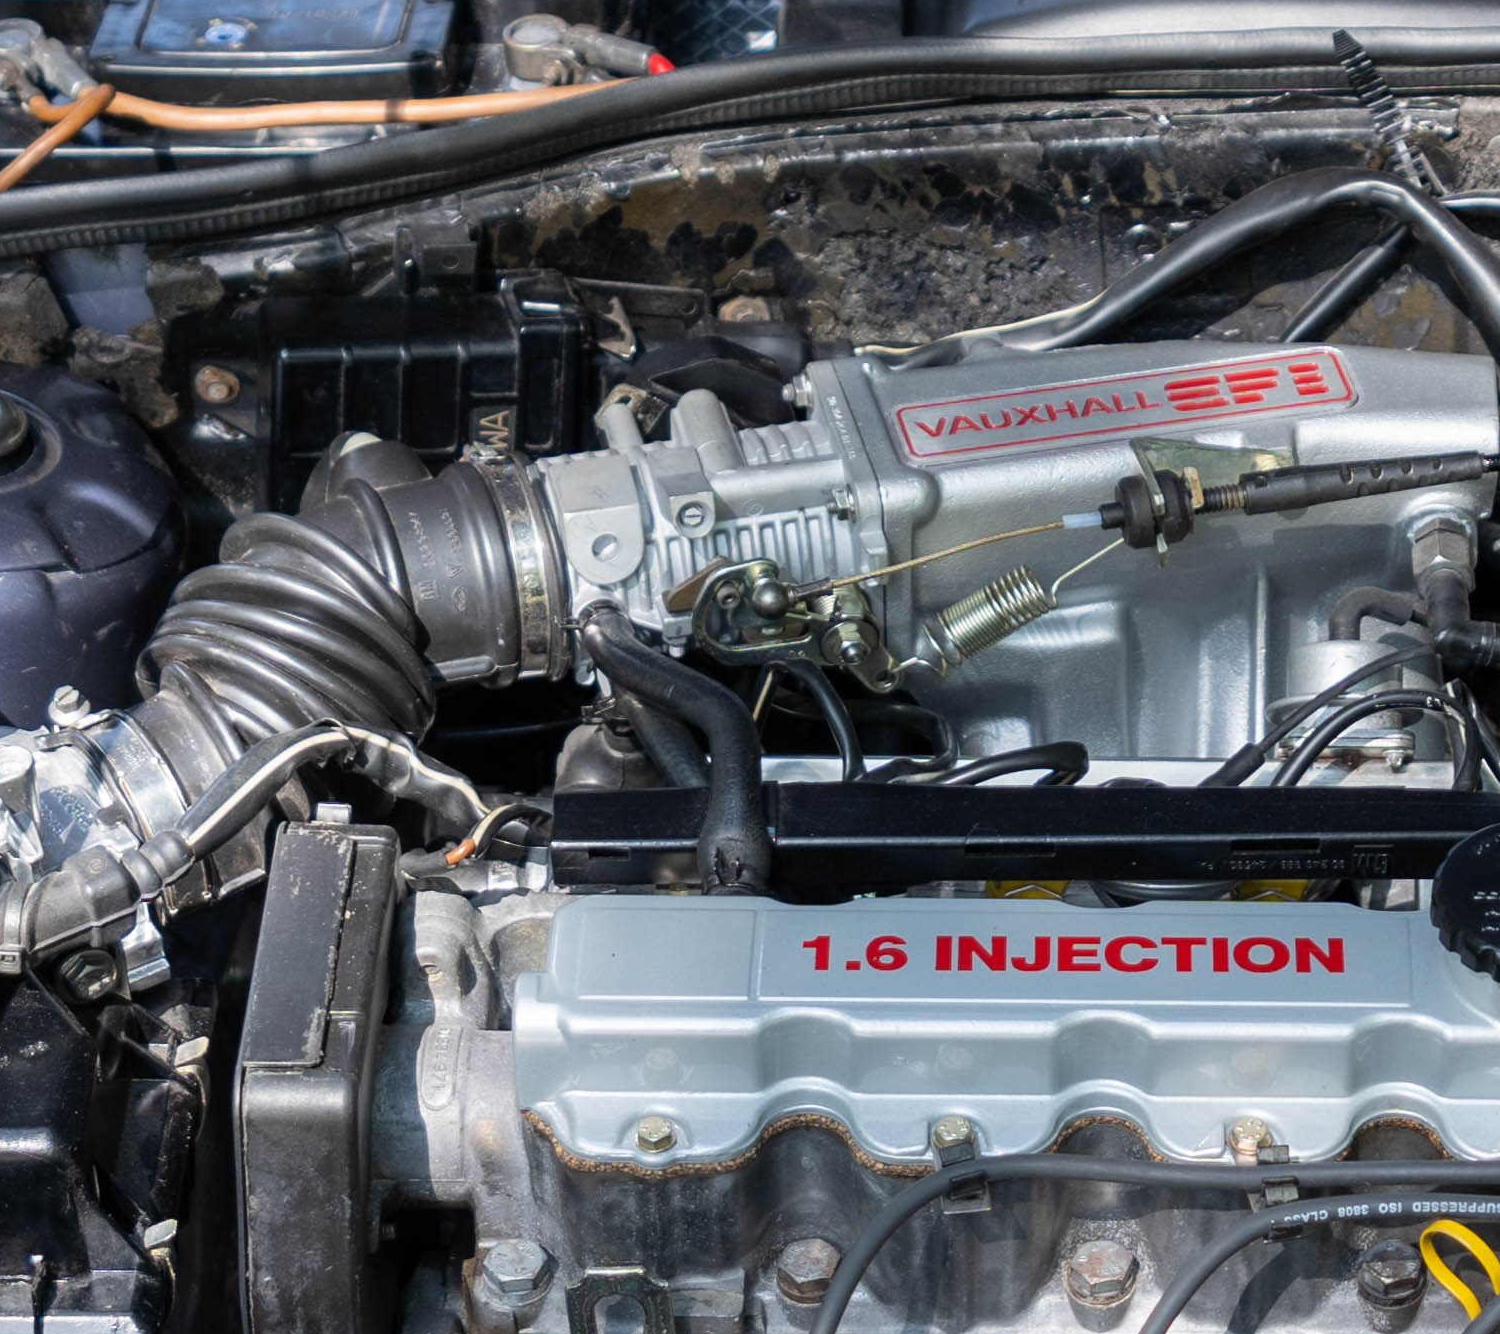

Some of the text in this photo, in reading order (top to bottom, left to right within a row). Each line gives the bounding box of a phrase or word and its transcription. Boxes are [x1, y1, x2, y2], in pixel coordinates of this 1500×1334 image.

[915, 389, 1163, 440] VAUXHALL
[1164, 360, 1330, 414] EFI
[802, 934, 1345, 974] 1.6 INJECTION
[1377, 1201, 1404, 1215] ISO
